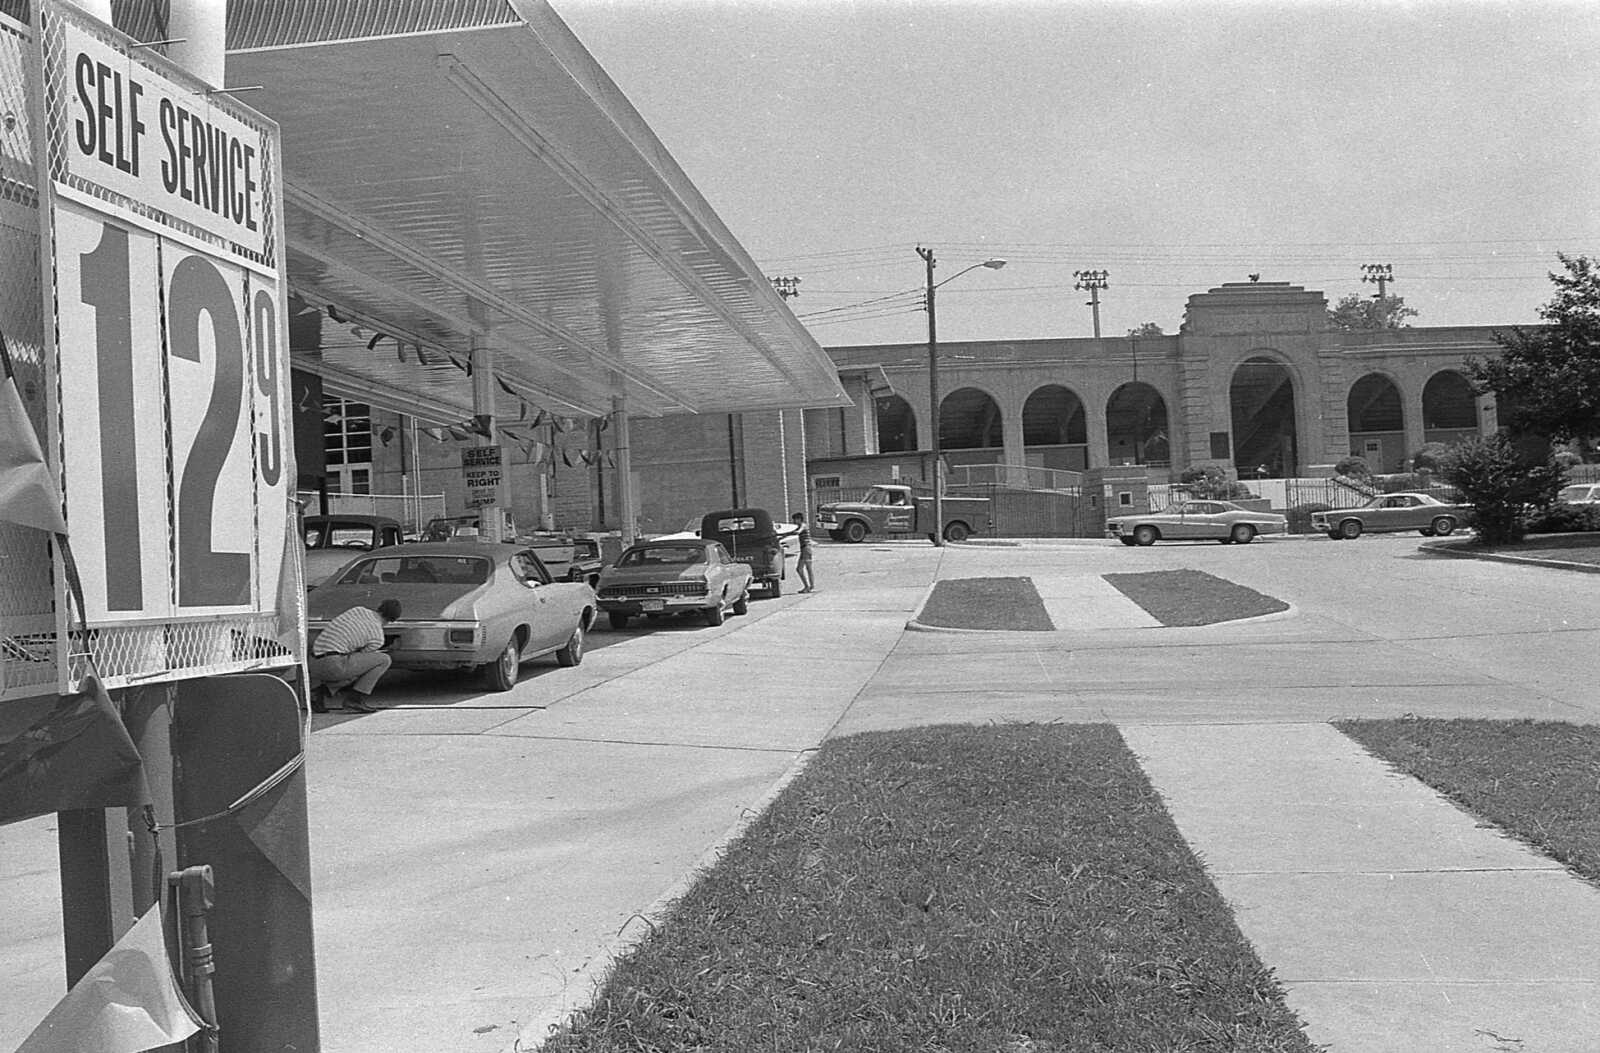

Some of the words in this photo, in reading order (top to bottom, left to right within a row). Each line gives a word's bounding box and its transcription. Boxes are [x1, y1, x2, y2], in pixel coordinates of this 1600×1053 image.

[75, 52, 146, 178] SELF
[160, 97, 258, 232] SERVICE
[467, 448, 496, 457] SELF
[463, 456, 501, 466] SERVICE
[467, 477, 501, 487] RIGHT
